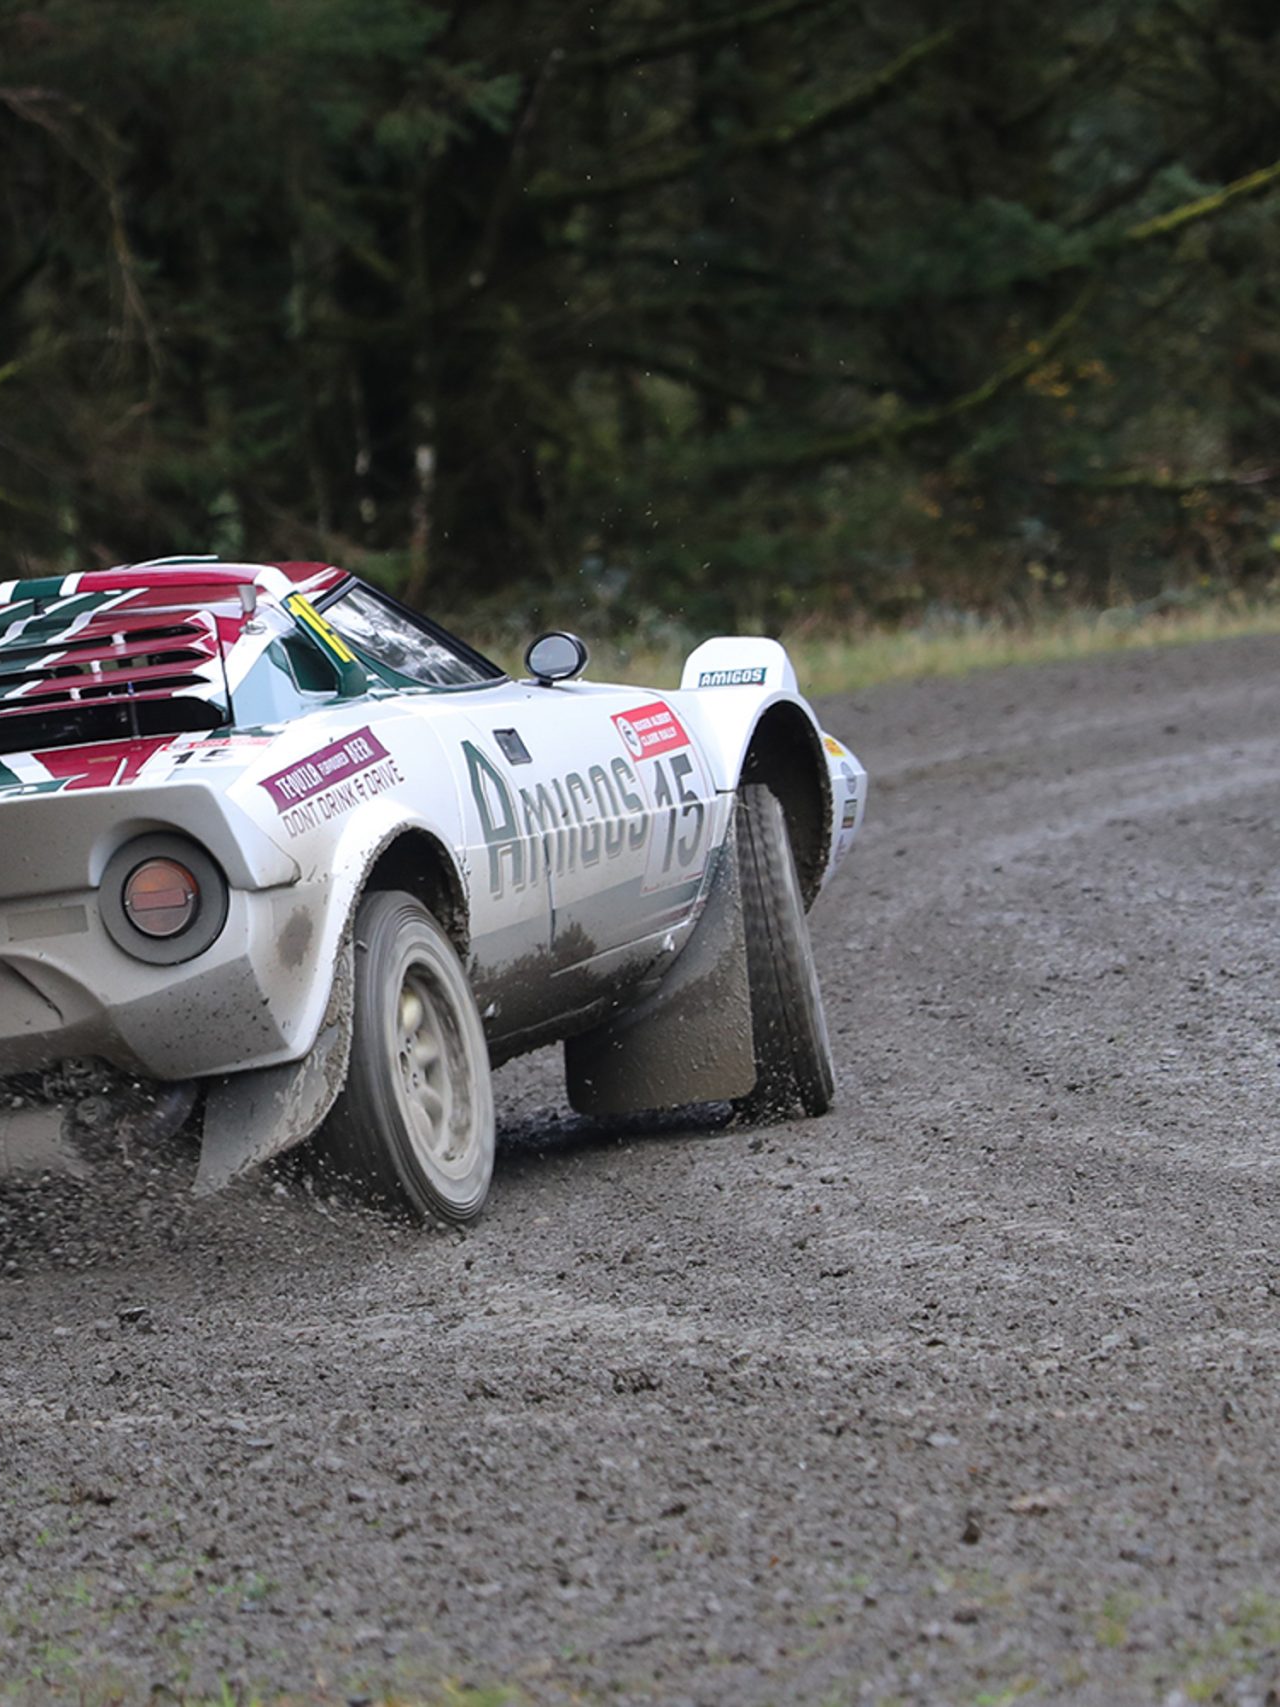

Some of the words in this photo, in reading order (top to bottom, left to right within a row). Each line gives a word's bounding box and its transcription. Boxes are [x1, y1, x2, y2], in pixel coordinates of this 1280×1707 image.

[701, 669, 763, 687] AMIGOS
[274, 762, 324, 799] TEQUILA
[342, 737, 375, 765] BEER
[282, 801, 321, 839] DONT
[317, 782, 360, 821] DRINK
[354, 779, 370, 802] &
[364, 760, 404, 796] DRIVE
[652, 753, 704, 874] 15
